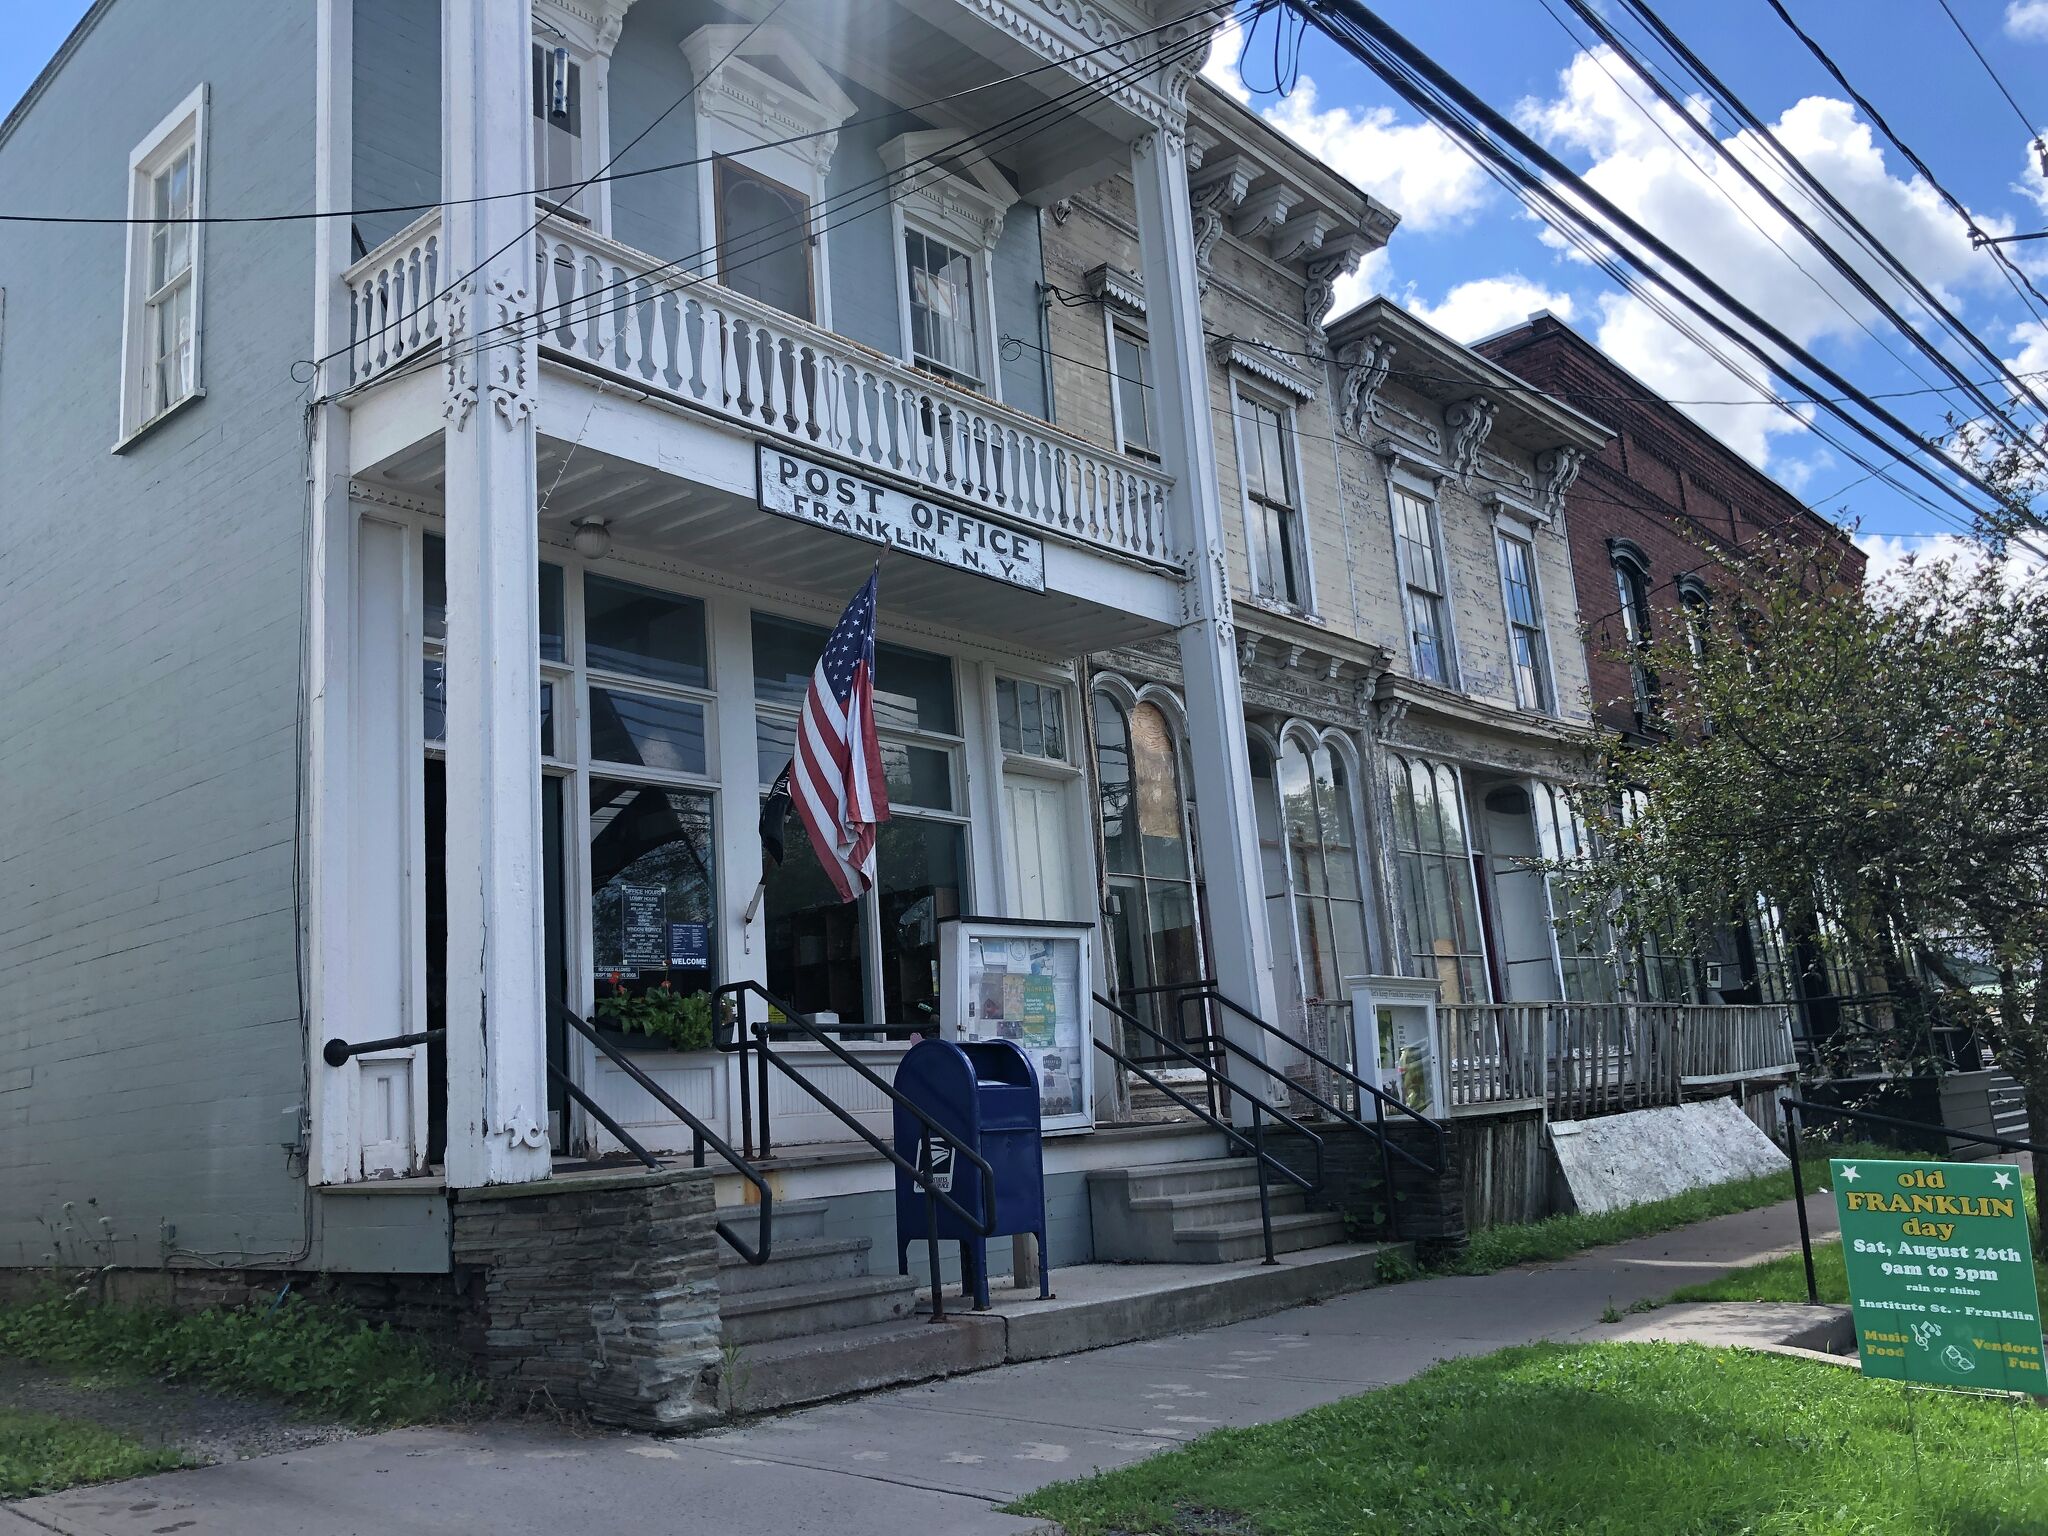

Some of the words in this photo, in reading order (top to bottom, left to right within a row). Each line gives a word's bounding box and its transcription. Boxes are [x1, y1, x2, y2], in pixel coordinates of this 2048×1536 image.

[779, 456, 885, 514] POST
[911, 502, 1030, 563] OFFICE
[962, 548, 986, 570] N.
[999, 559, 1018, 579] Y.
[1898, 1169, 1946, 1189] old
[1846, 1192, 2015, 1218] FRANKLIN
[1902, 1217, 1955, 1242] day
[1853, 1239, 1892, 1257] Sat,
[1898, 1241, 1970, 1260] August
[1975, 1247, 2021, 1263] 26th
[1880, 1262, 1923, 1276] 9am
[1927, 1264, 1949, 1278] to
[1954, 1266, 1998, 1283] 3pm
[1906, 1283, 1931, 1293] rain
[1933, 1285, 1947, 1294] or
[1949, 1286, 1981, 1297] shine
[1859, 1298, 1926, 1313] Institute
[1930, 1304, 1952, 1314] St.
[1964, 1306, 2034, 1321] Franklin
[1864, 1330, 1909, 1343] Music
[1972, 1338, 2039, 1355] Vendors
[1866, 1345, 1905, 1358] Food
[2008, 1357, 2041, 1371] Fun
